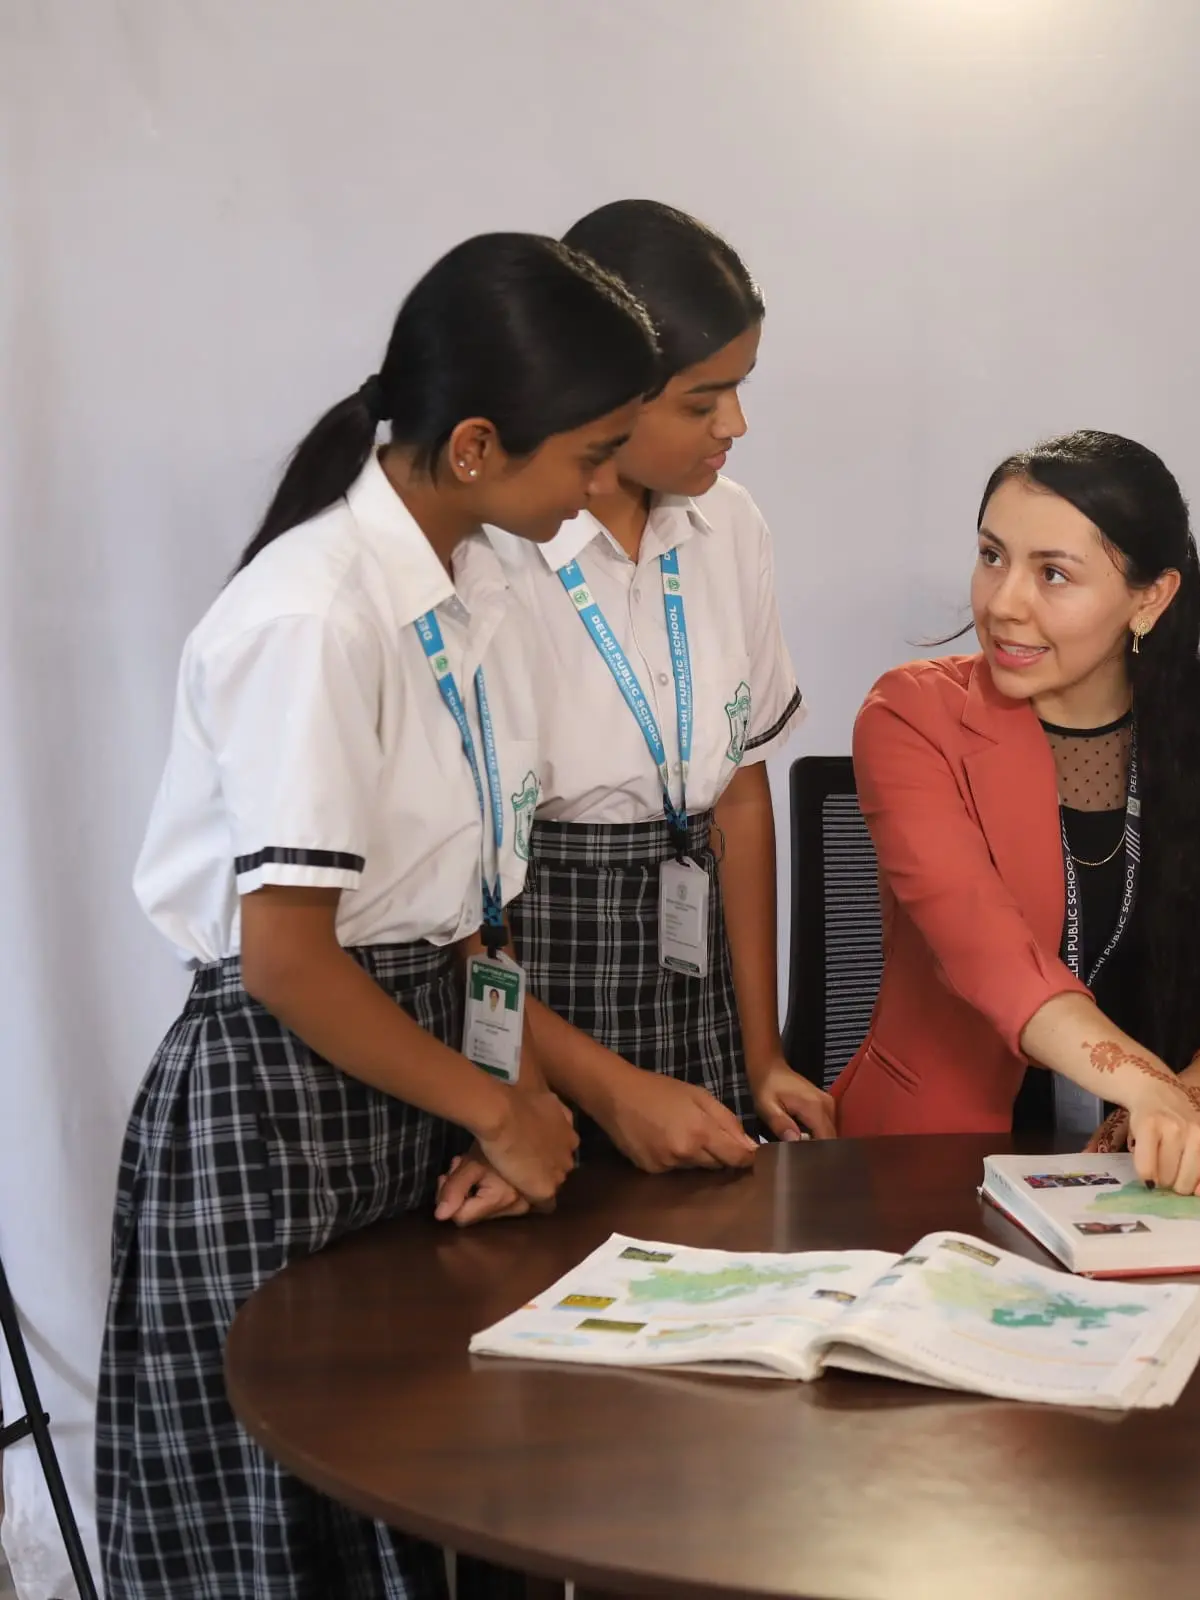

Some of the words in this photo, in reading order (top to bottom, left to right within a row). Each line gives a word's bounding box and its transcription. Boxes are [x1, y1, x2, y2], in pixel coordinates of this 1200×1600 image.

[670, 604, 683, 657] SCHOOL
[591, 615, 616, 650] DELHI
[612, 652, 640, 697] PUBLIC
[637, 699, 661, 750] SCHOOL
[676, 659, 687, 706] PUBLIC
[680, 708, 689, 747] DELHI
[1129, 761, 1137, 793] DELHI
[1065, 855, 1077, 905] SCHOOL
[1067, 908, 1079, 951] PUBLIC
[1086, 957, 1106, 986] DELHI
[1103, 915, 1126, 956] PUBLIC
[1122, 863, 1135, 913] SCHOOL
